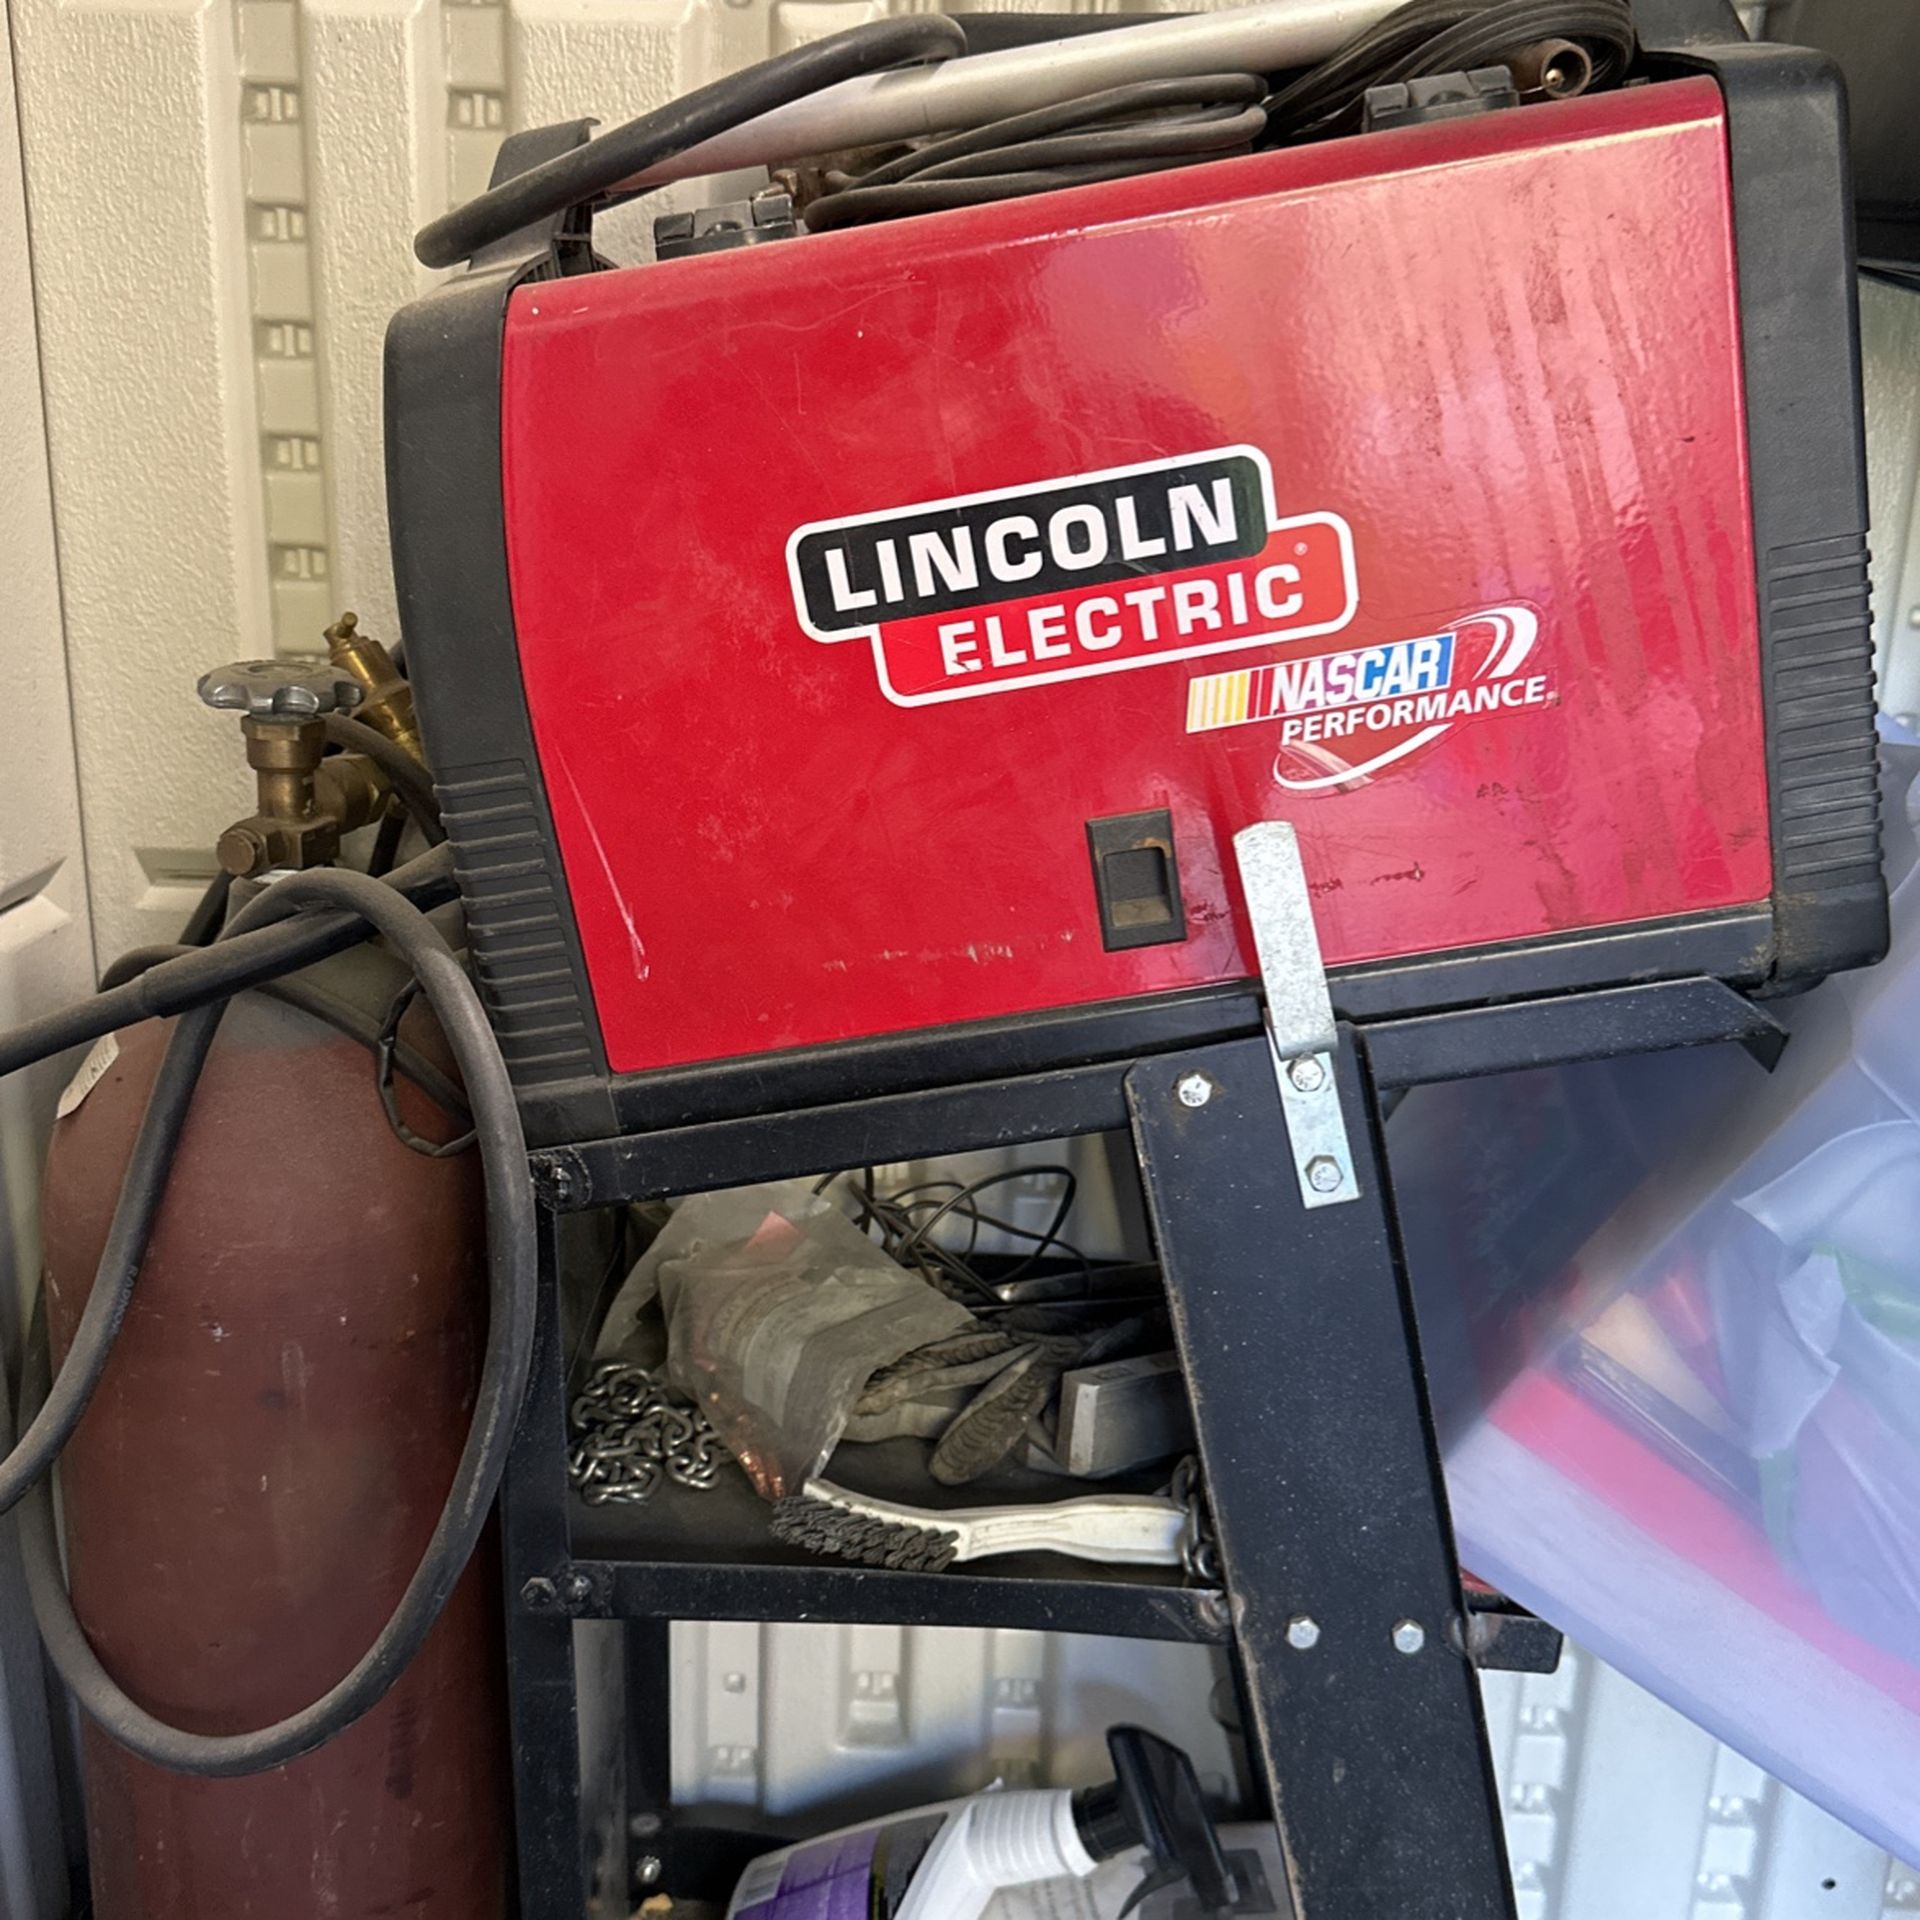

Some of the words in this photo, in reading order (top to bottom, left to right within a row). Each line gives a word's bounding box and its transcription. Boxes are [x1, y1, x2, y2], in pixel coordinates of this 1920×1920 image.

[824, 477, 1239, 612] LINCOLN
[938, 562, 1303, 676] ELECTRIC
[1272, 638, 1441, 715] NASCAR
[1282, 676, 1547, 747] PERFORMANCE
